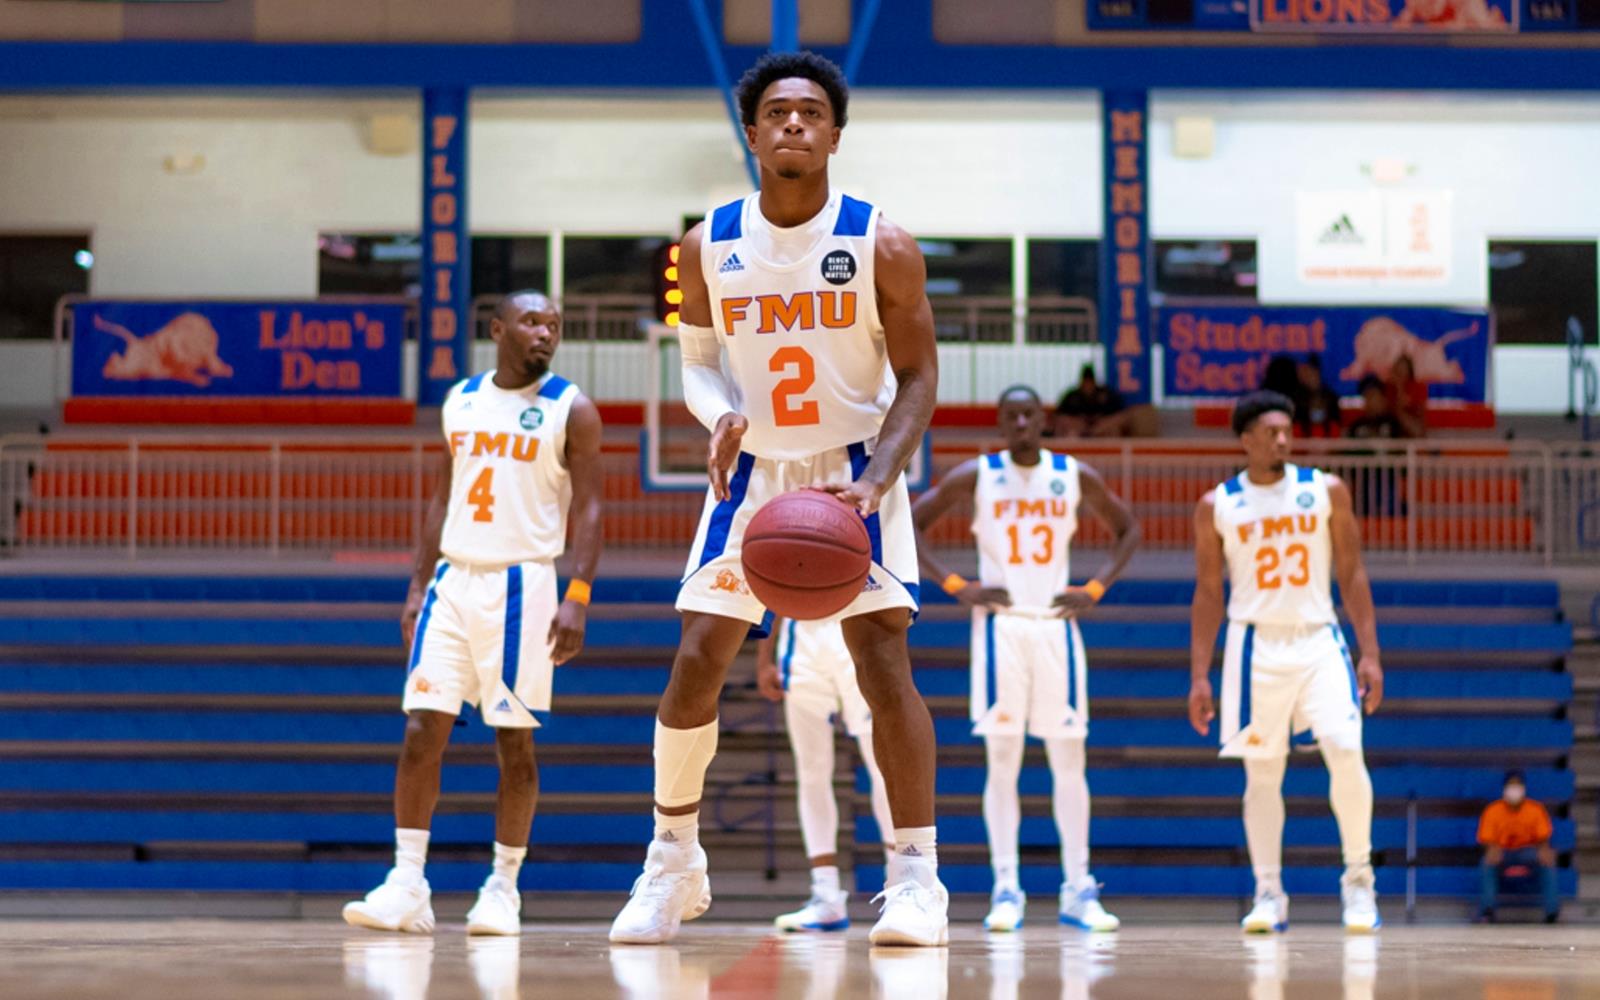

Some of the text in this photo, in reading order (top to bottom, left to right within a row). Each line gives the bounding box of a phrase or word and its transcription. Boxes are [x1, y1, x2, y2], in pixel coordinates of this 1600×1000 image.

[429, 115, 456, 380] FLORIDA
[1111, 111, 1142, 393] MEMORIAL
[259, 311, 385, 349] Lion's
[721, 291, 857, 336] FMU
[1169, 314, 1326, 352] Student
[281, 352, 361, 390] Den
[769, 346, 820, 427] 2
[1175, 351, 1268, 391] Sect
[450, 431, 540, 463] FMU
[467, 467, 496, 522] 4
[993, 498, 1067, 519] FMU
[1006, 524, 1054, 565] 13
[1237, 513, 1317, 544] FMU
[1255, 543, 1310, 590] 23
